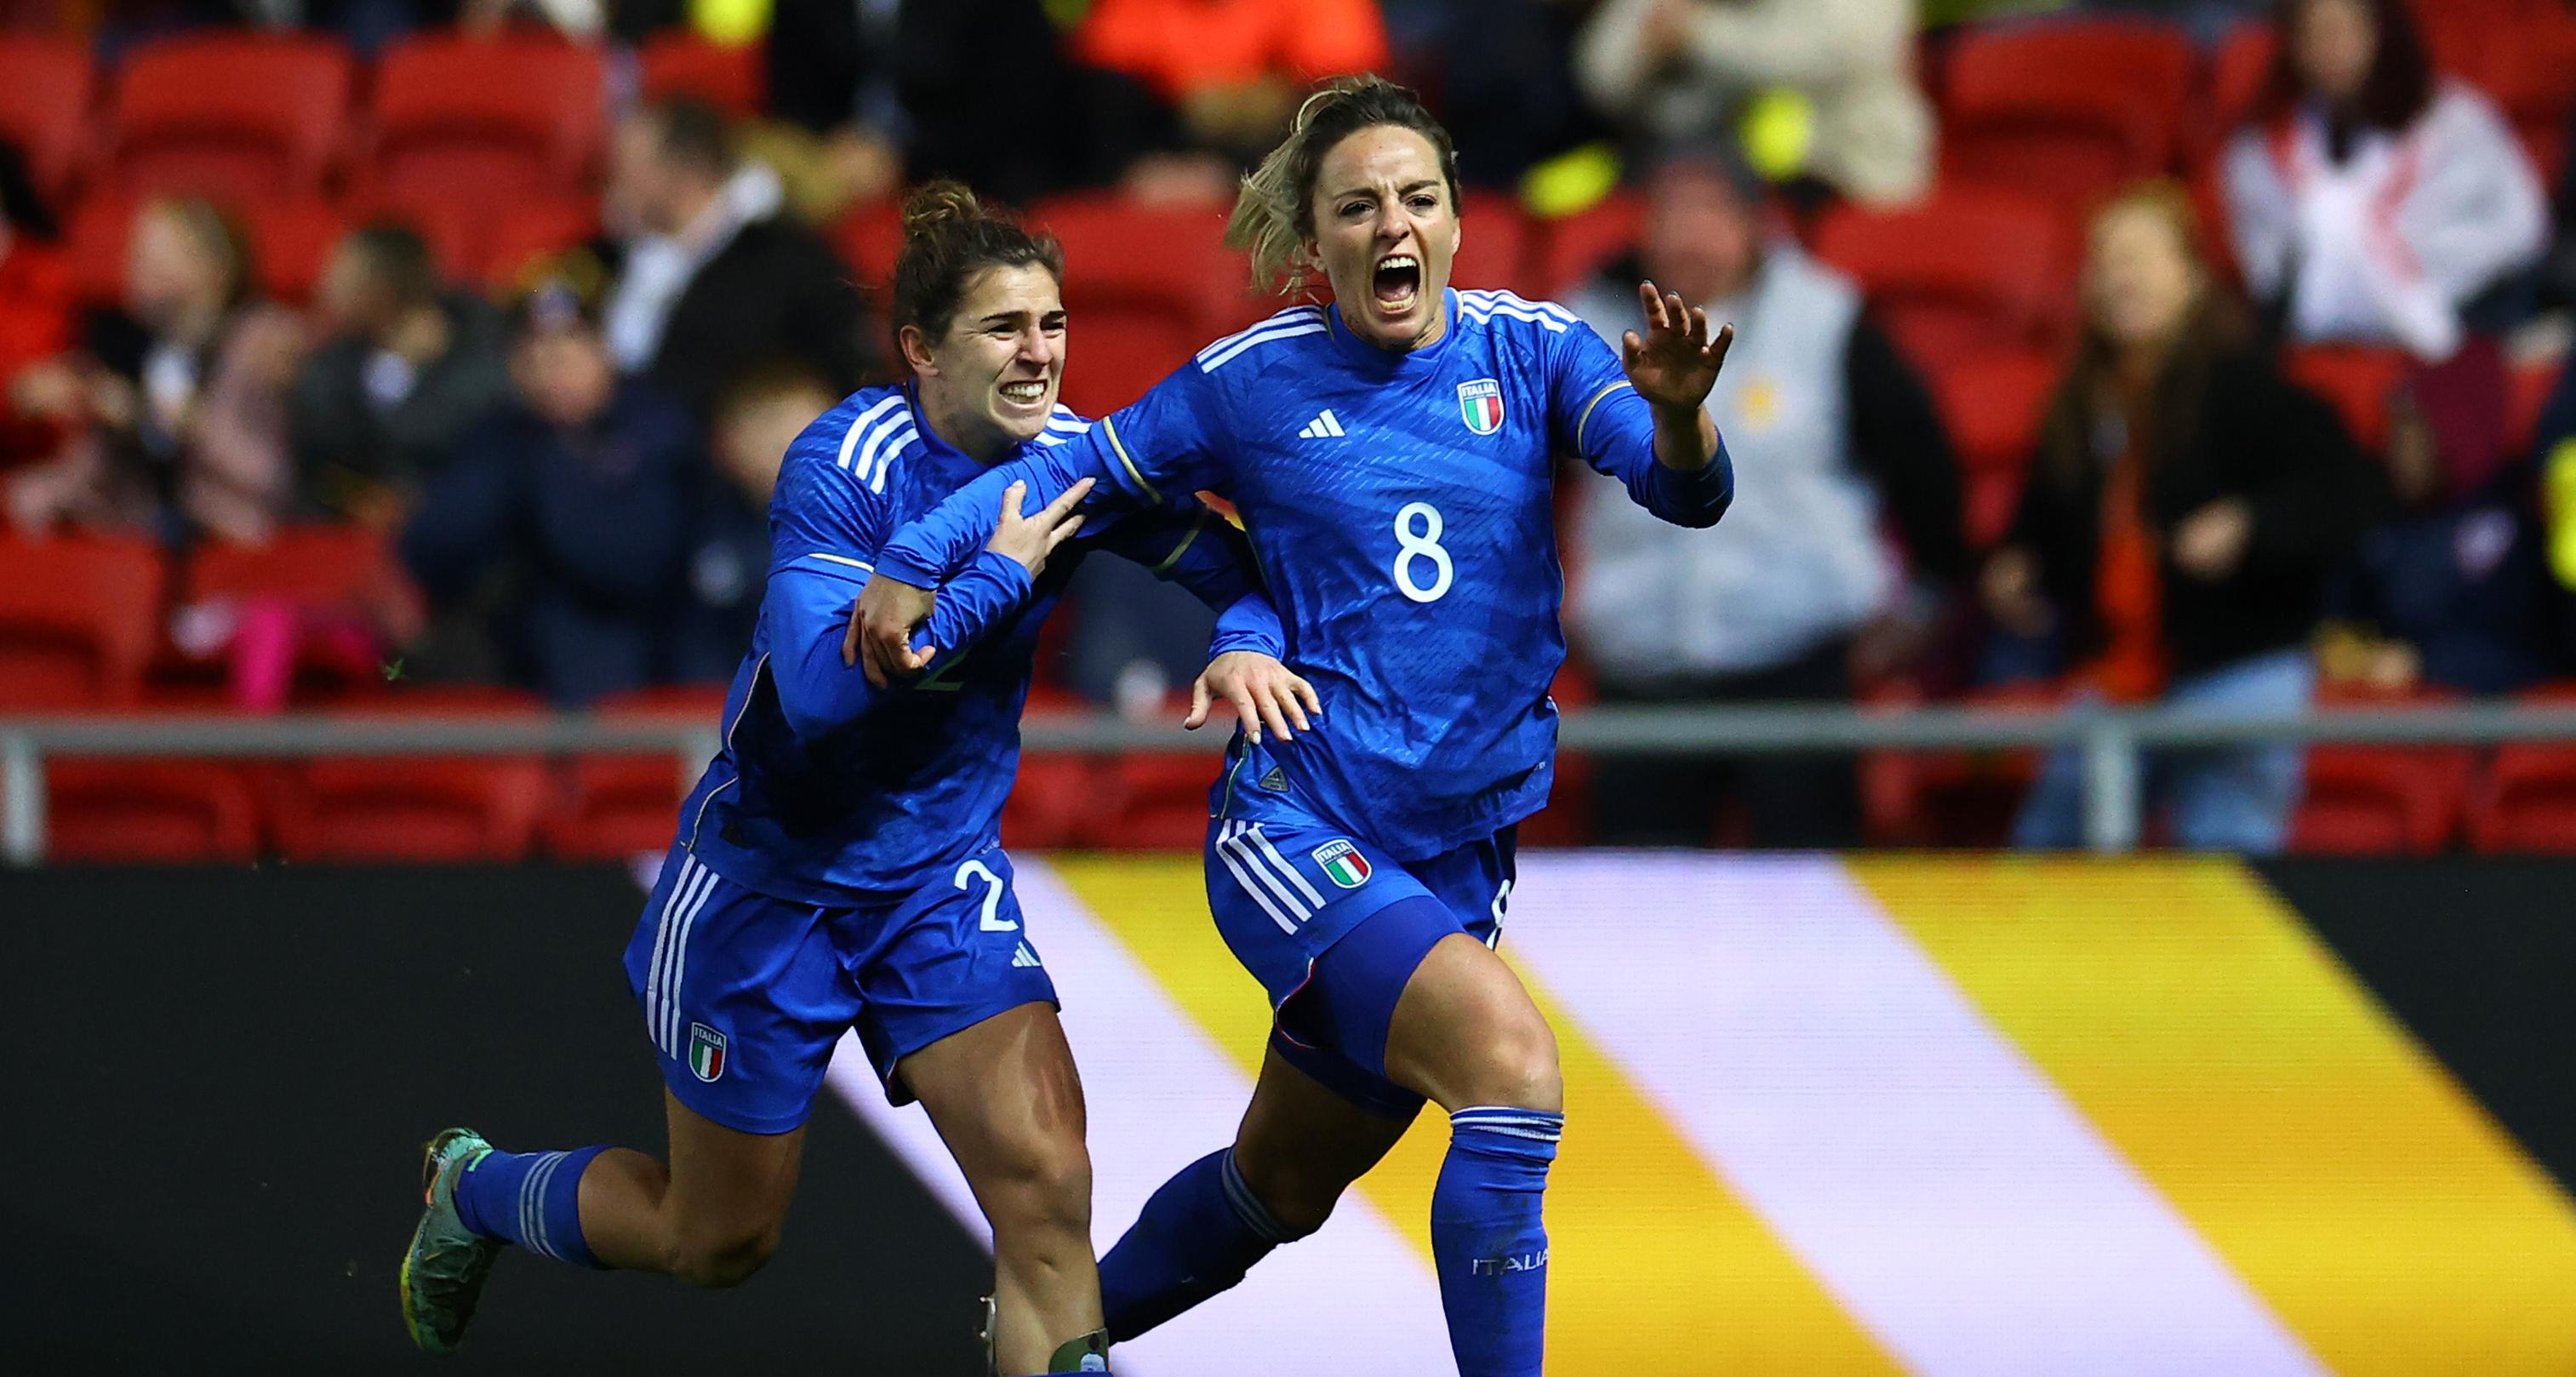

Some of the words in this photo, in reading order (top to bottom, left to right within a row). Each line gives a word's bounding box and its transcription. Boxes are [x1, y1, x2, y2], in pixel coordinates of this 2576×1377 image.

[1460, 382, 1498, 397] ITALIA
[1393, 501, 1454, 603] 8
[1316, 843, 1352, 862] ITALIA
[954, 859, 1020, 932] 2
[694, 1026, 723, 1048] ITALIA
